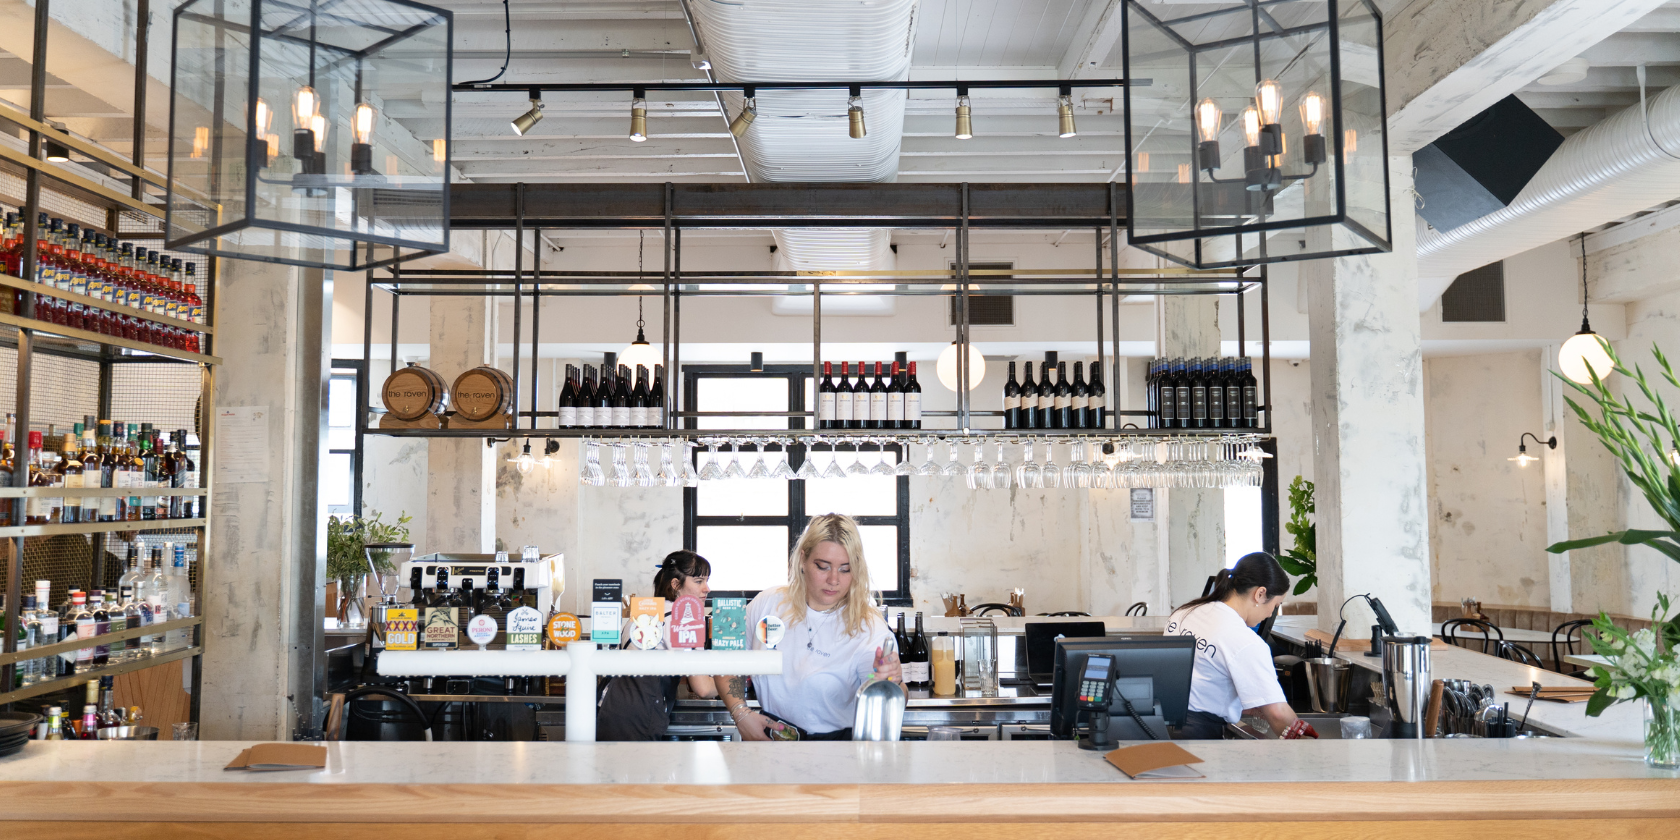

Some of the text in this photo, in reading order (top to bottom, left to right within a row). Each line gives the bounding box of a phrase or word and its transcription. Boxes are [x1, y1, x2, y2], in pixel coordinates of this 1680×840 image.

[54, 272, 70, 281] APER
[70, 276, 87, 286] APER
[389, 390, 427, 398] the raven
[717, 599, 742, 608] BALLISTIC
[385, 620, 418, 632] XXXX
[553, 621, 576, 629] STONE
[427, 626, 455, 634] GREAT
[553, 630, 576, 638] WOOD
[387, 633, 415, 644] GOLD
[511, 634, 537, 644] LASHES
[678, 630, 698, 644] IPA
[714, 639, 744, 647] HAZY PALE
